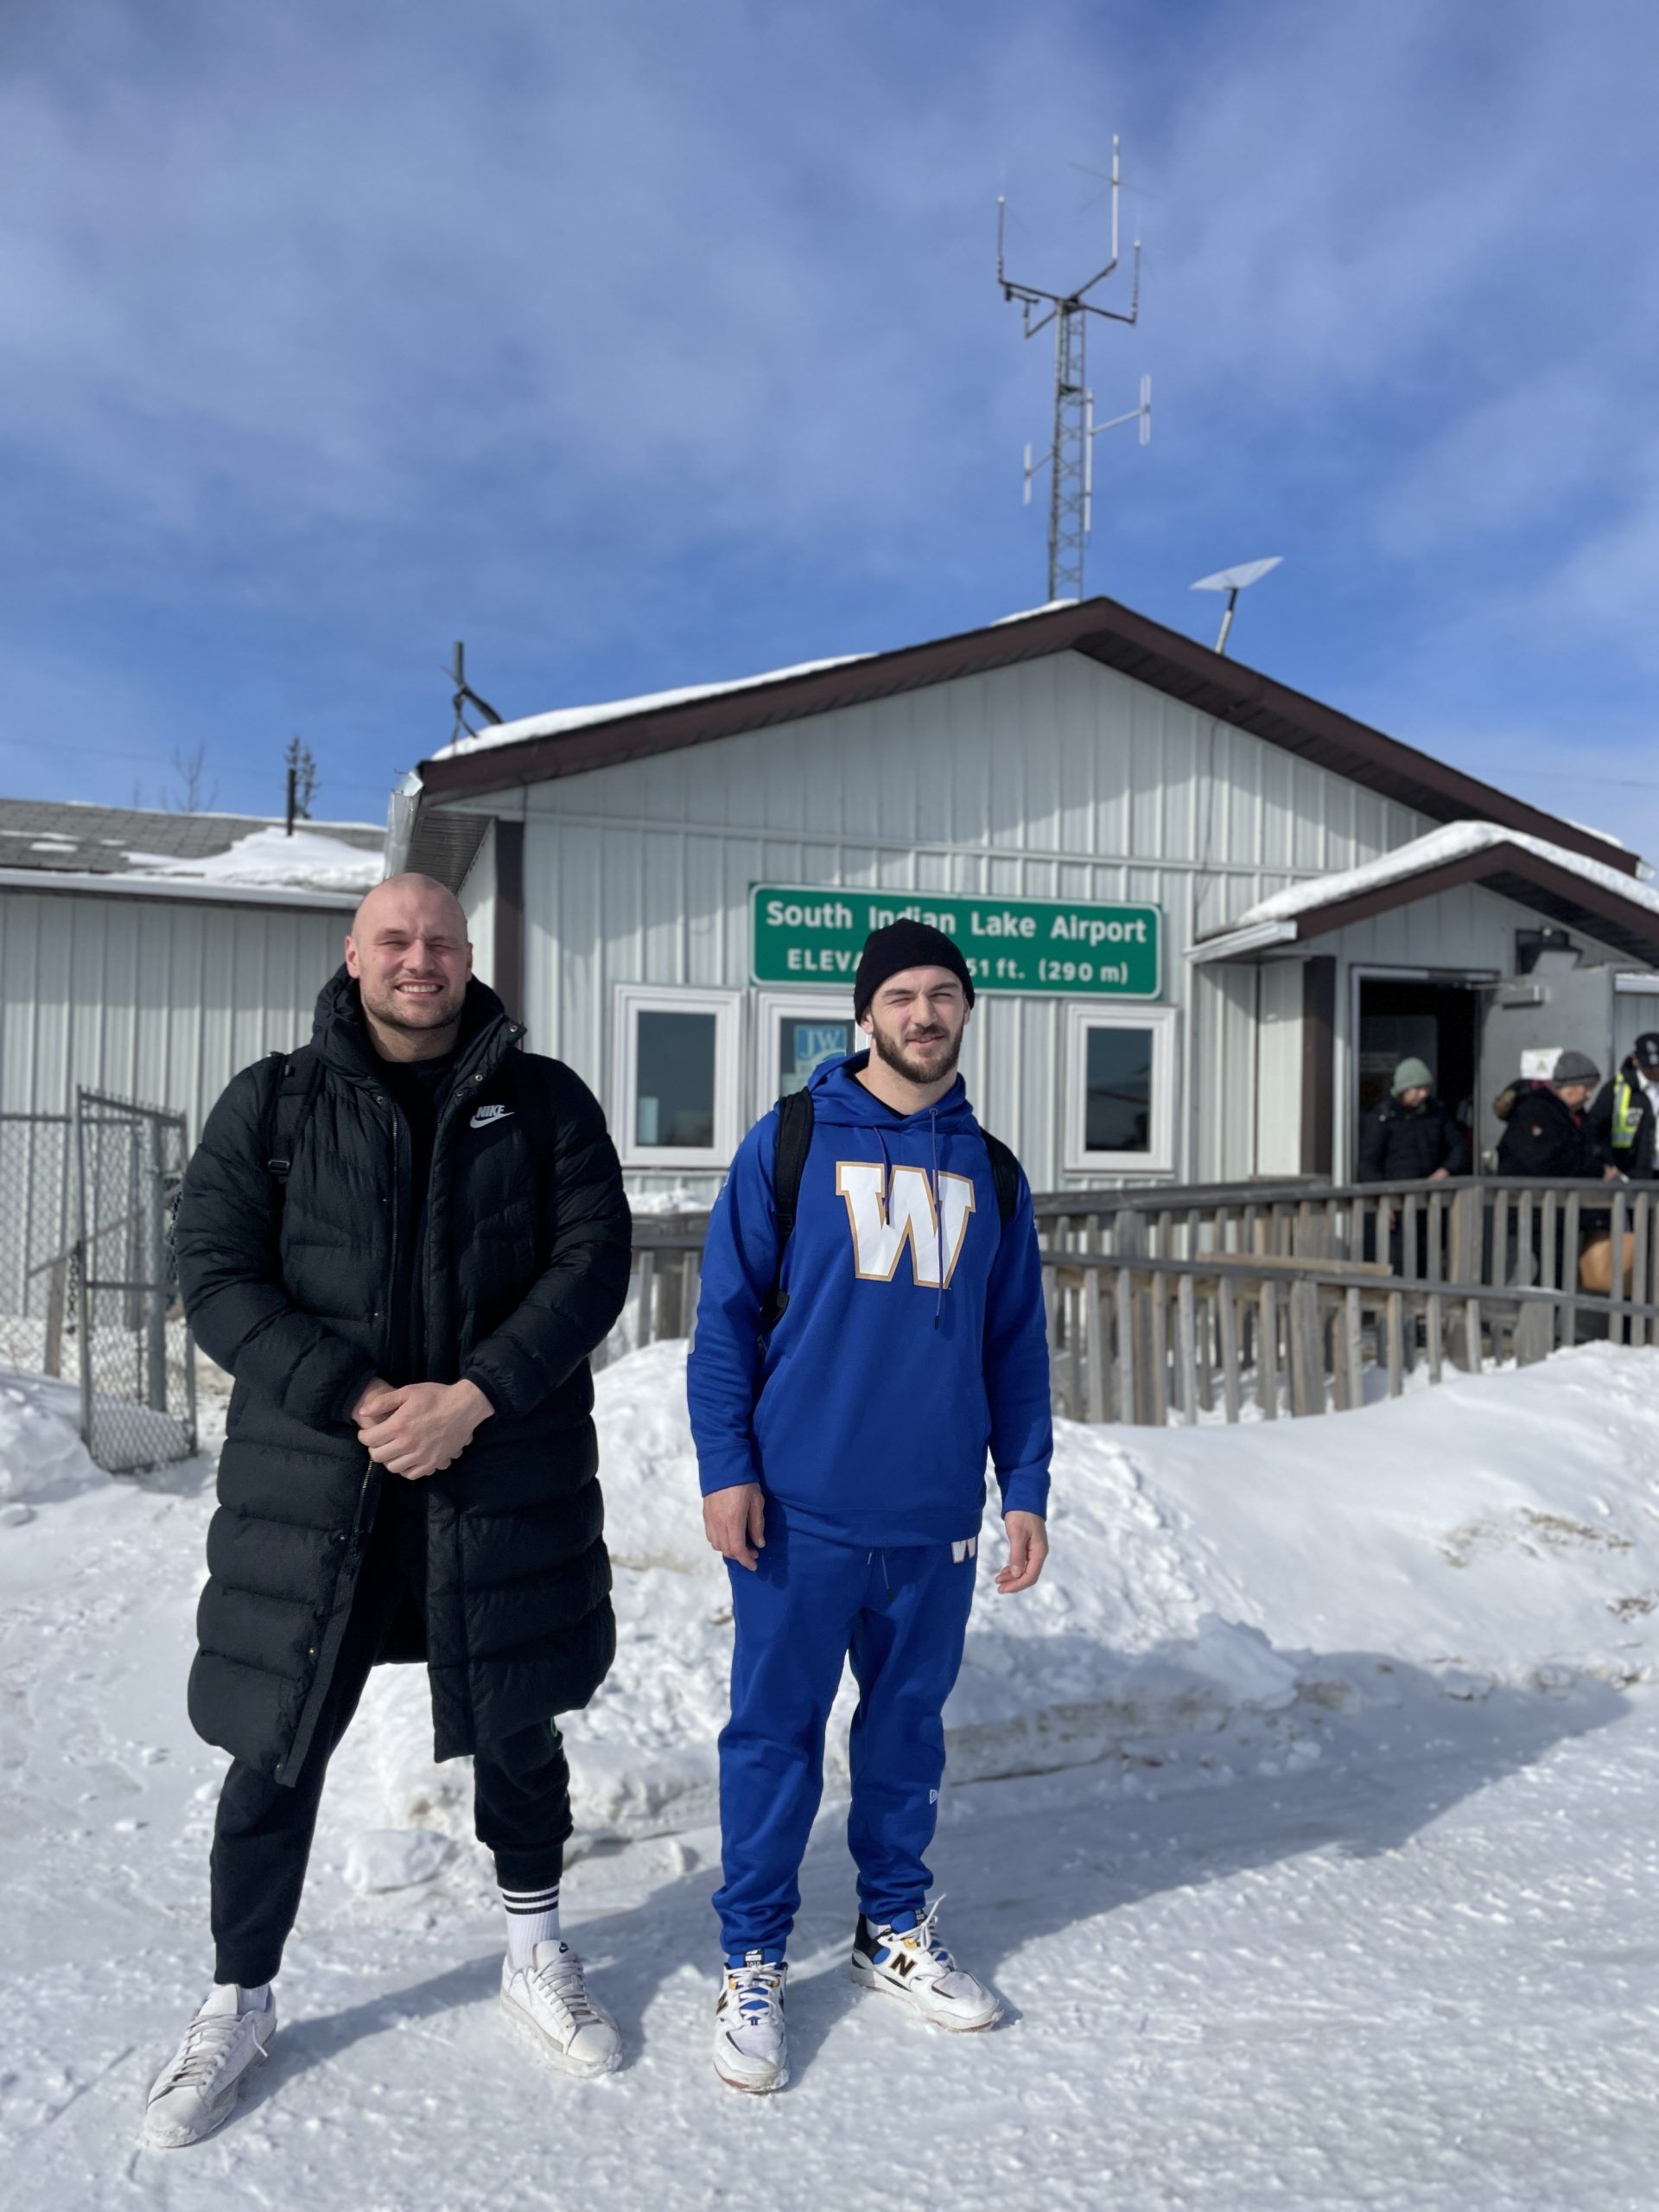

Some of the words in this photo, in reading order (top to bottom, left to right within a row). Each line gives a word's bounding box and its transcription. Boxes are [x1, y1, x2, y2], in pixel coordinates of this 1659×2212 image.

[766, 900, 853, 929] South
[971, 911, 1036, 938] Lake
[1050, 914, 1147, 946] Airport
[996, 957, 1026, 979] ft.
[1038, 957, 1093, 982] (290
[1100, 962, 1128, 985] m)
[476, 1105, 505, 1118] NIKE
[836, 1161, 976, 1290] W
[889, 1951, 918, 1979] N
